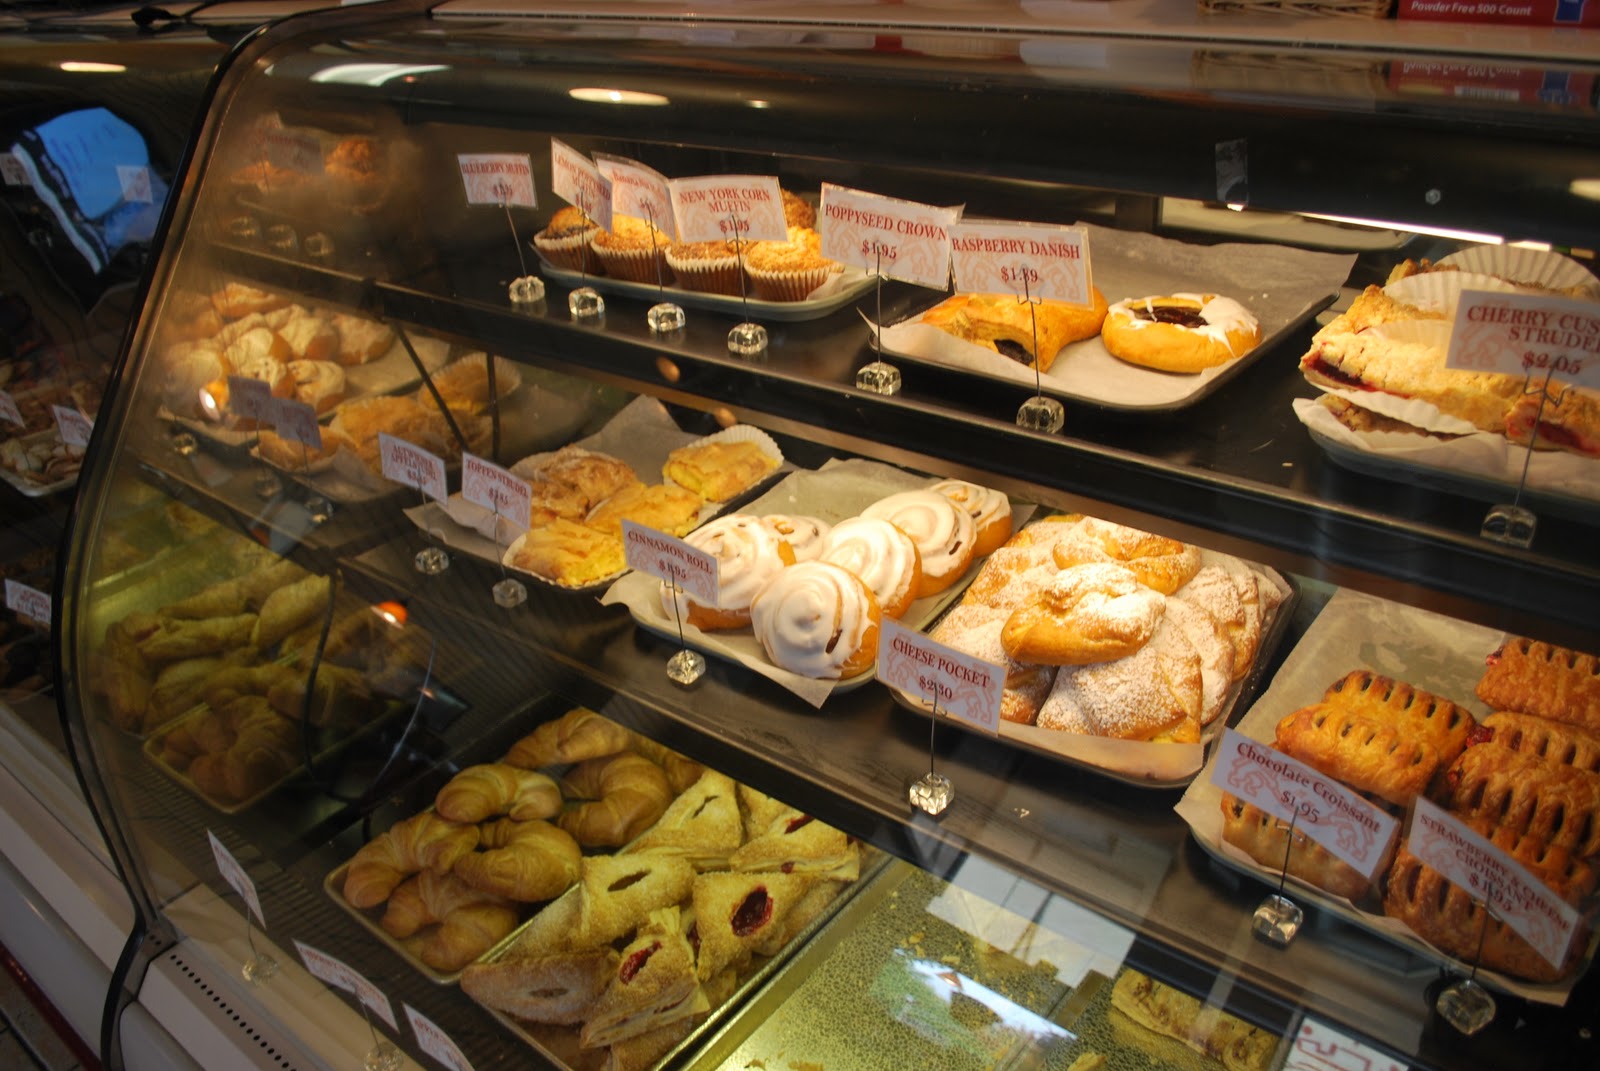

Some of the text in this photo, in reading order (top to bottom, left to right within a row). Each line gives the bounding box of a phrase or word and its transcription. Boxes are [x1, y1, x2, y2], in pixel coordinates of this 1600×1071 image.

[1410, 1, 1532, 16] Powder Free 500 Count
[680, 188, 772, 205] NEW YORK CORN
[708, 201, 752, 213] MUFFIN
[719, 219, 751, 234] $195
[824, 203, 948, 241] POPPYSEED CROWN
[861, 240, 897, 260] $1.95
[951, 238, 1081, 260] RASPBERRY DANISH
[1000, 265, 1039, 284] $1.89
[1466, 305, 1554, 328] CHERRY
[1521, 350, 1584, 376] $2.05
[627, 530, 713, 575] CINNAMON ROLL
[658, 559, 687, 579] $195
[892, 637, 991, 688] CHEESE POCKET
[918, 675, 953, 701] $230
[1237, 742, 1382, 833] Chocolate Croissant
[1279, 789, 1321, 825] $195
[1420, 813, 1510, 877] STRAWBERRY
[1521, 883, 1570, 932] CHEESE
[1454, 848, 1537, 912] CROISSANT
[1469, 872, 1513, 913] $195
